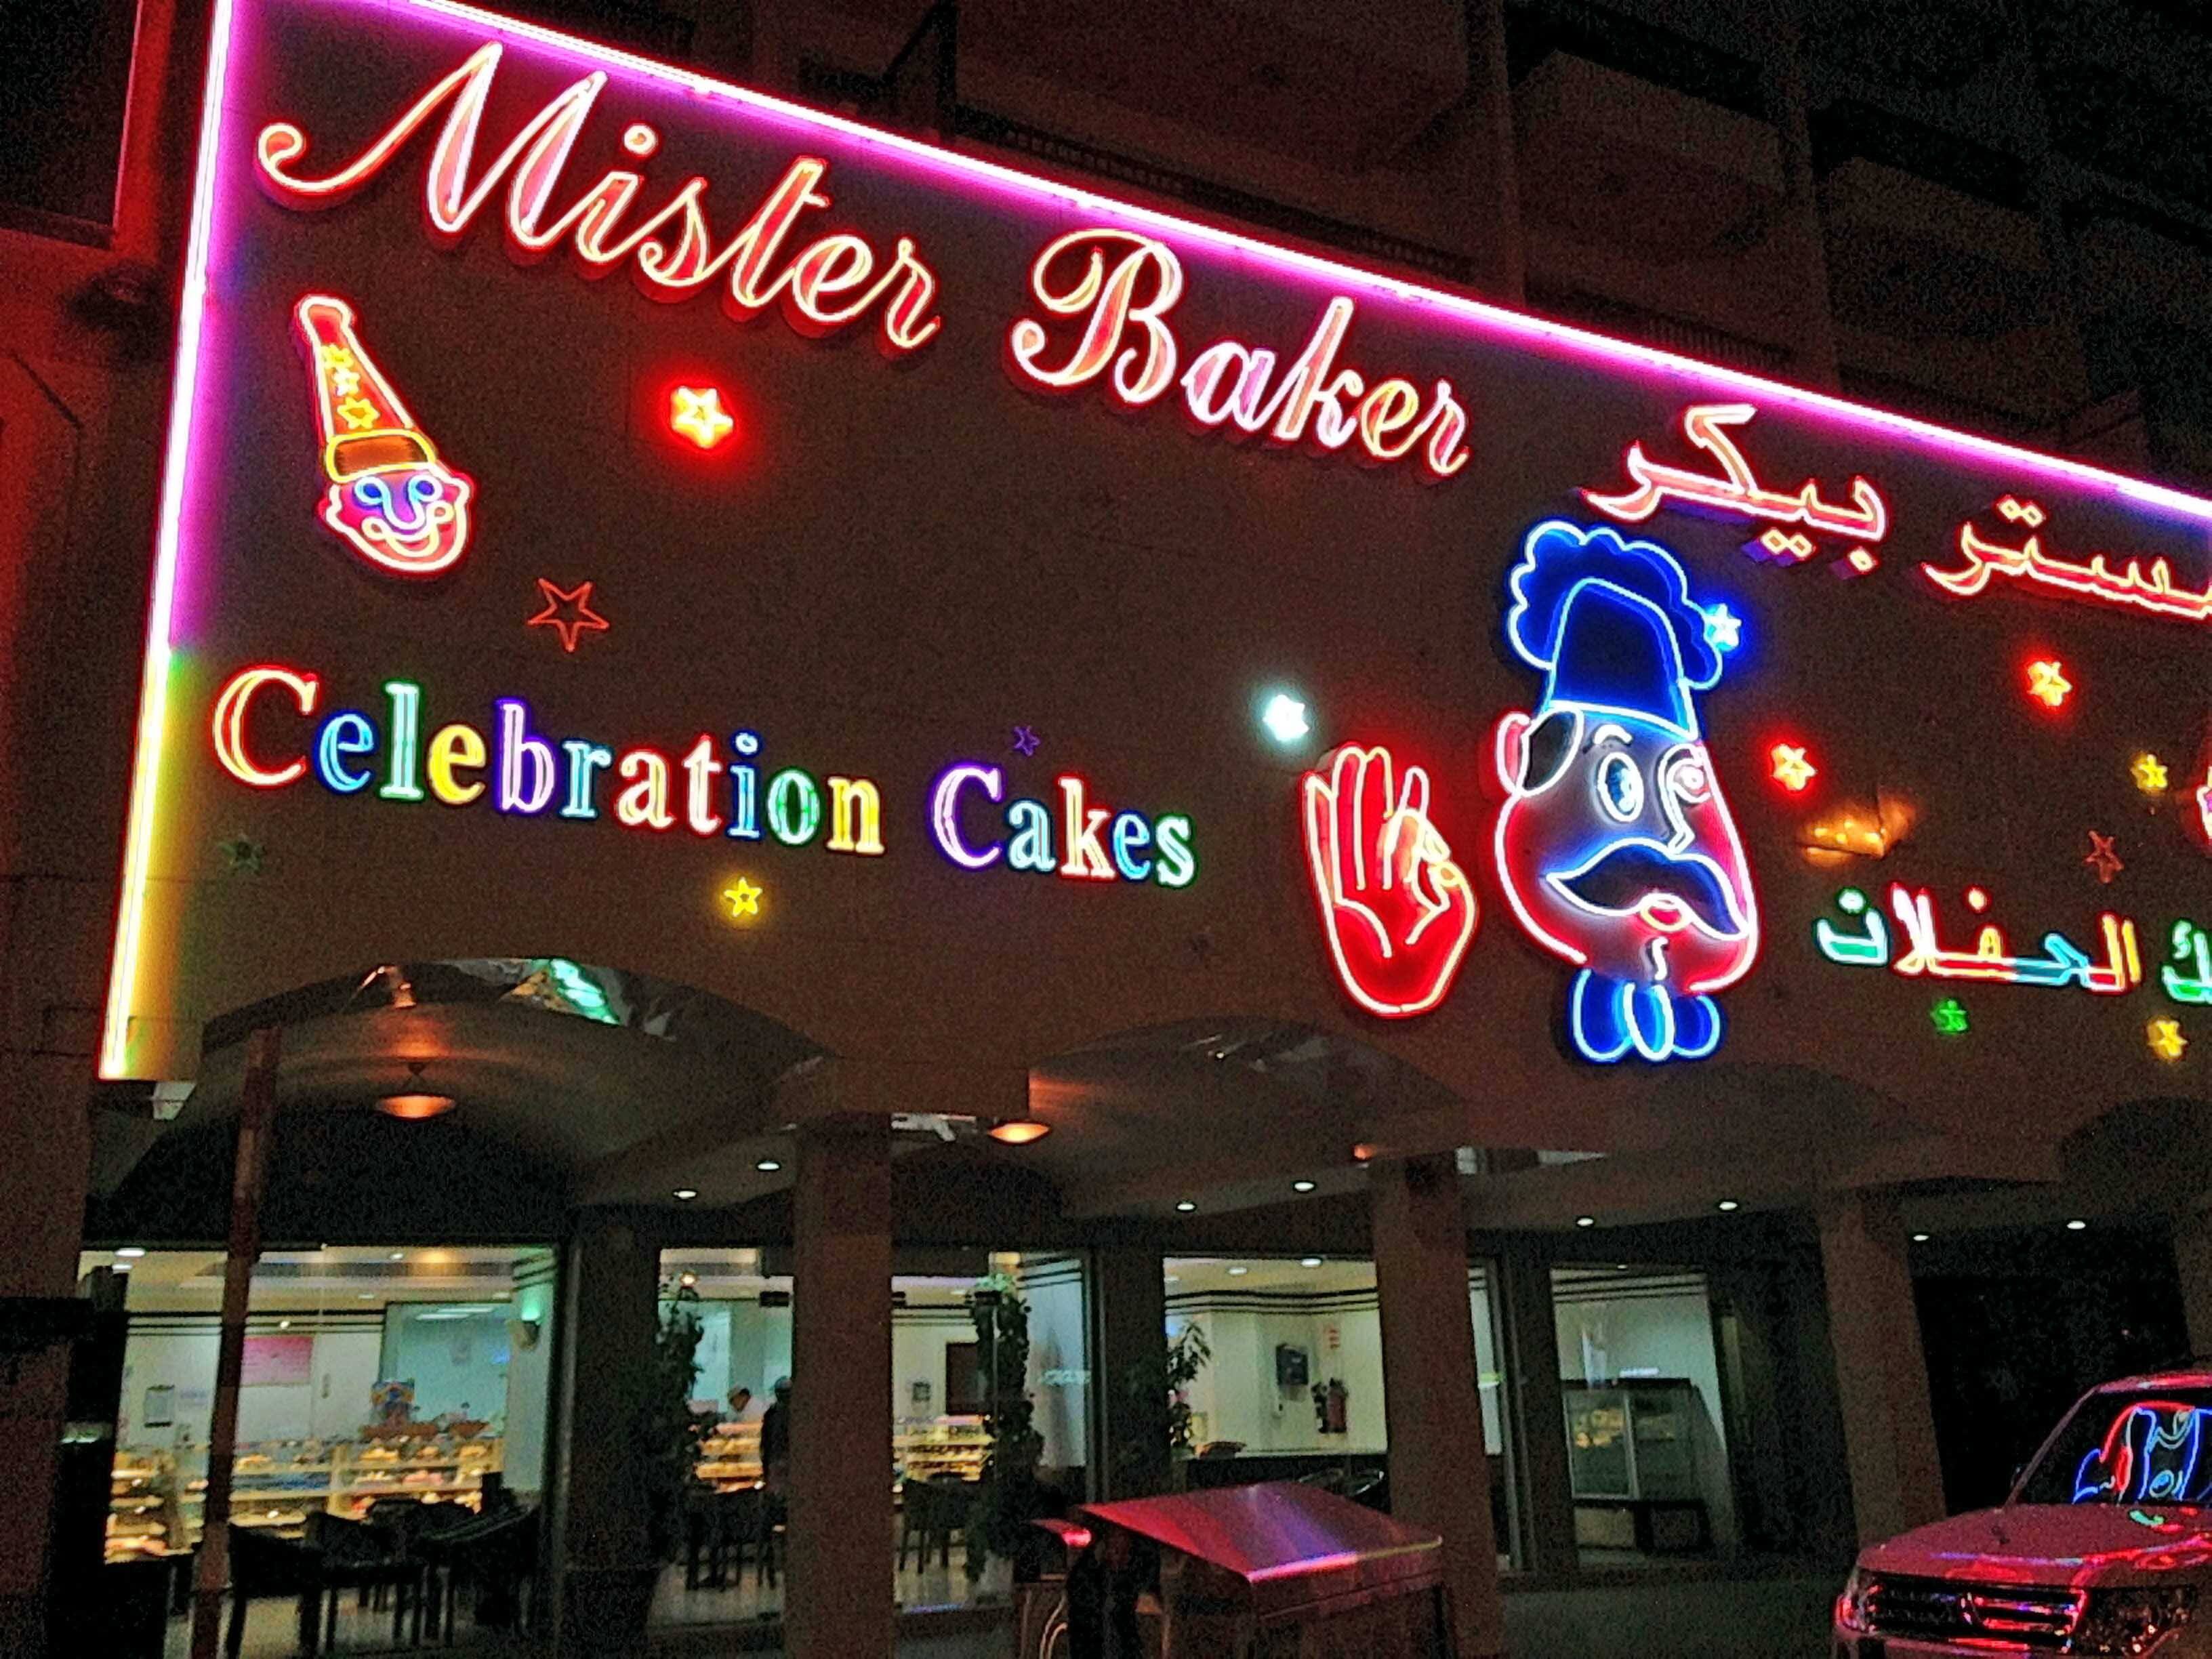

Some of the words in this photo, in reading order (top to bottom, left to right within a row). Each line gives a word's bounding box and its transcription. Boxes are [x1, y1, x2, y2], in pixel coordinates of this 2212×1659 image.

[256, 39, 941, 350] Mister
[1010, 228, 1471, 477] Baker
[1580, 404, 1885, 573] بيكر
[1922, 493, 2212, 619] ستر
[211, 664, 886, 855] Celebration
[931, 764, 1197, 887] Cakes
